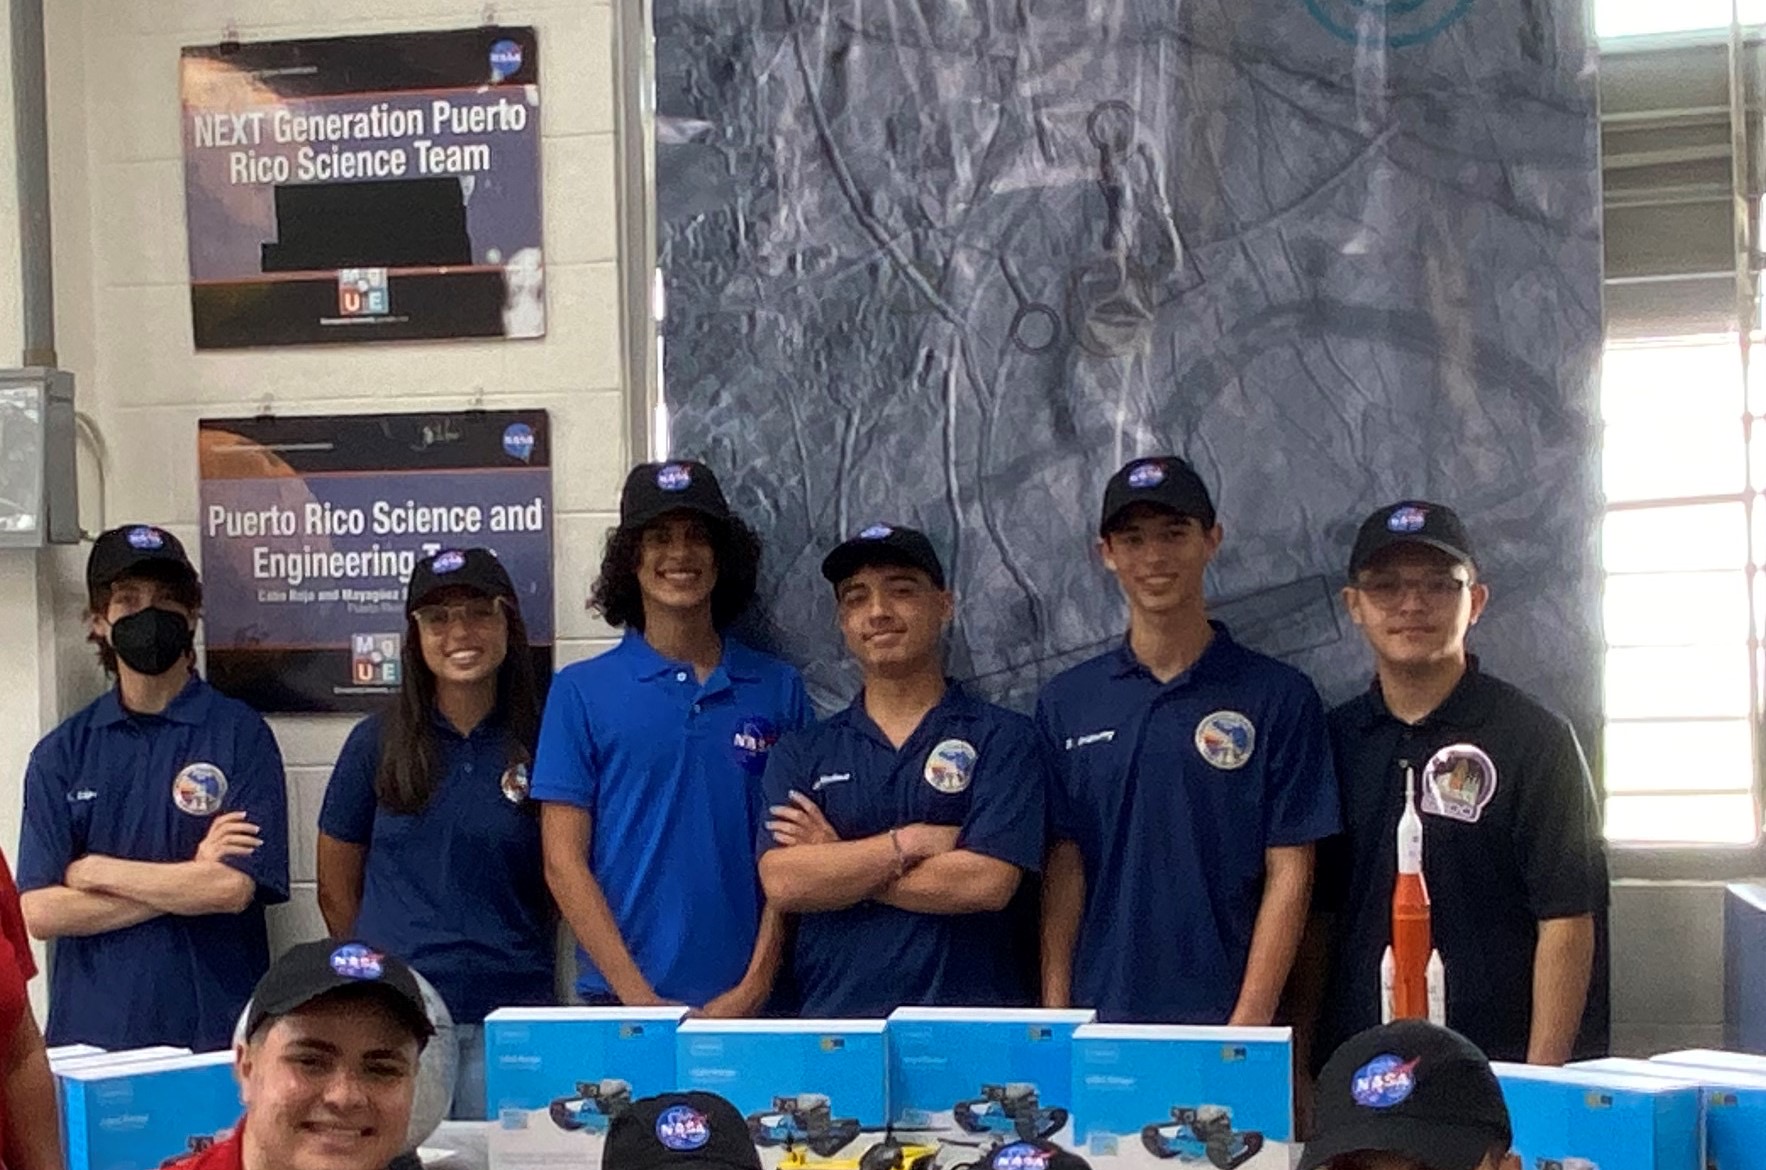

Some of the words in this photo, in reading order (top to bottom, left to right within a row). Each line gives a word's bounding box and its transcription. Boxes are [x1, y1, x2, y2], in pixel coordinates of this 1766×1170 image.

[194, 111, 264, 148] NEXT
[274, 103, 424, 143] Generation
[432, 98, 527, 135] Puerto
[230, 151, 289, 185] Rico
[297, 143, 406, 180] Science
[413, 139, 490, 173] Team
[208, 505, 297, 537] Puerto
[304, 502, 365, 535] Rico
[372, 500, 482, 533] Science
[489, 498, 543, 531] and
[253, 543, 415, 585] Engineering
[334, 955, 381, 971] NASA
[1357, 1072, 1408, 1091] NASA
[660, 1120, 706, 1138] NASA
[997, 1156, 1045, 1167] NASA
